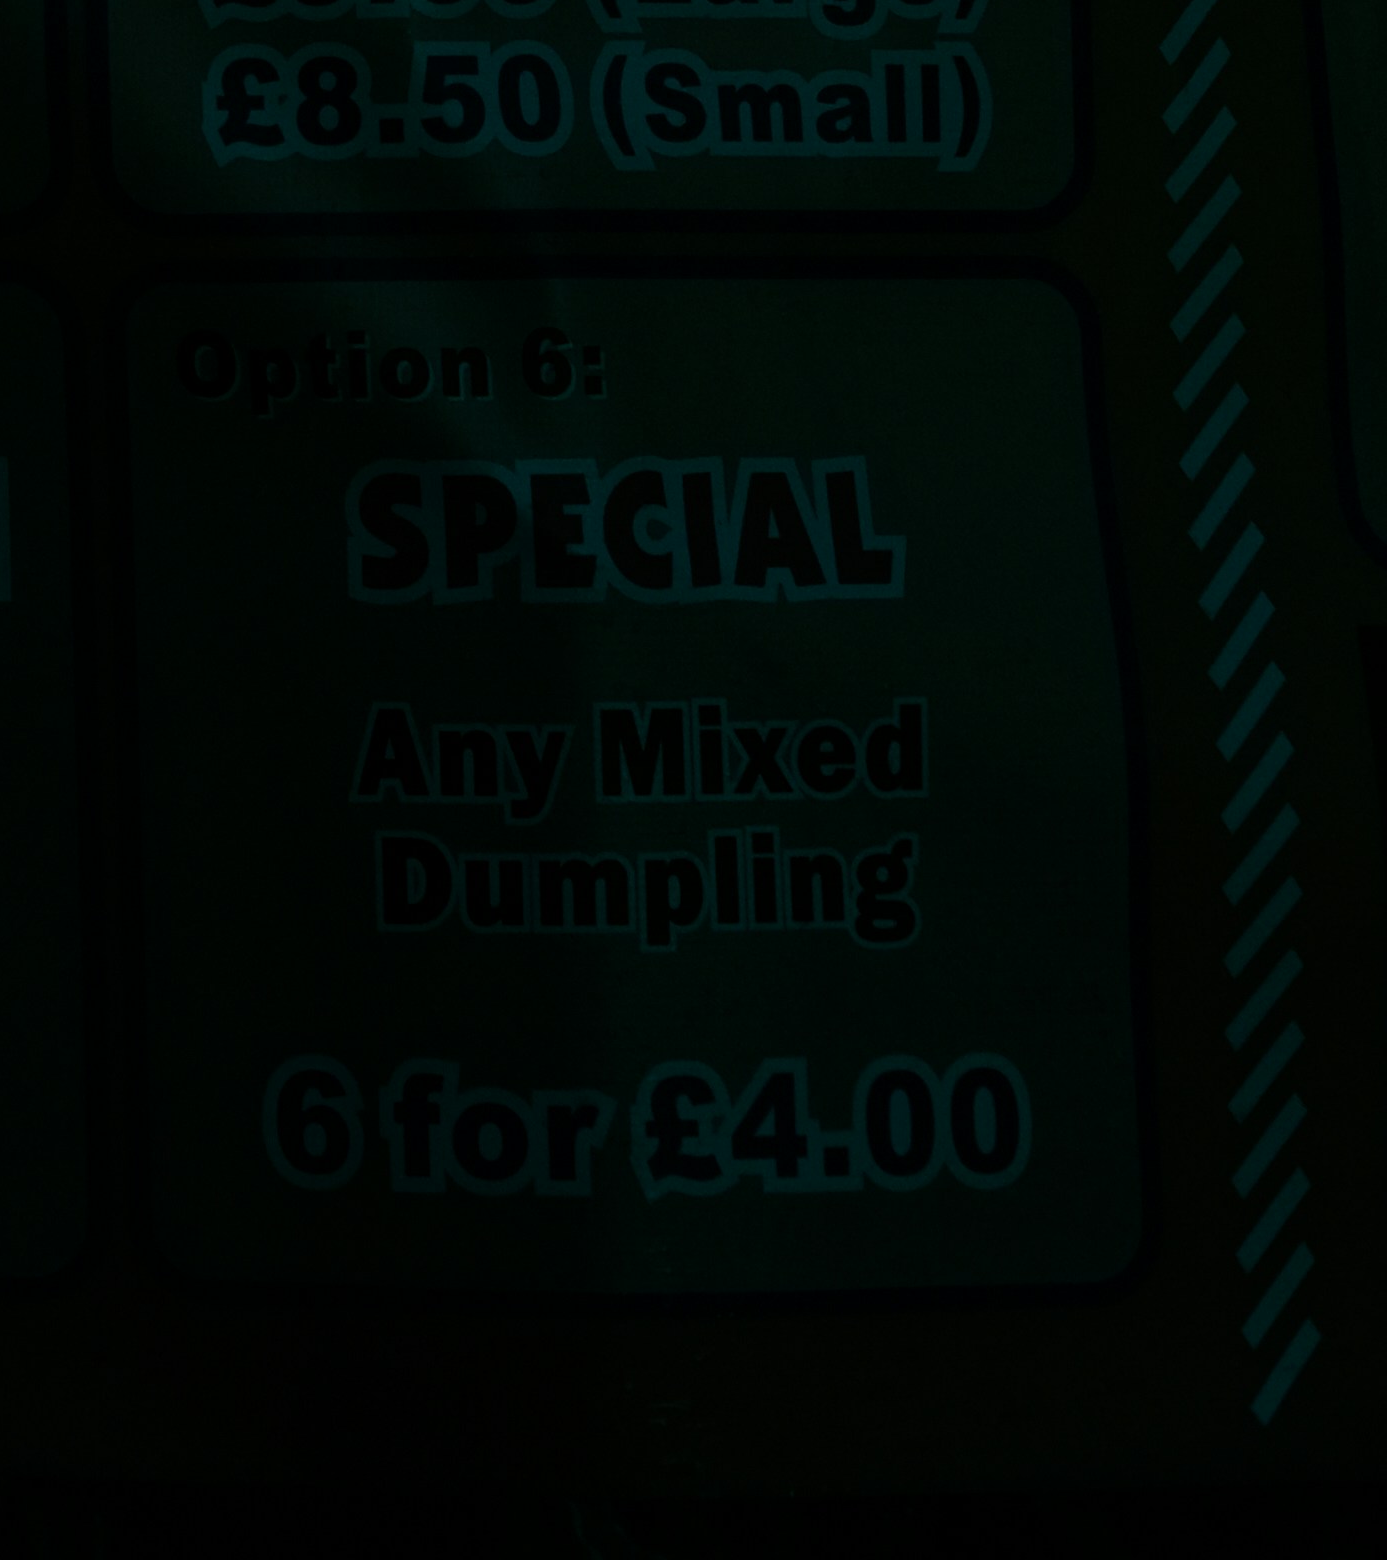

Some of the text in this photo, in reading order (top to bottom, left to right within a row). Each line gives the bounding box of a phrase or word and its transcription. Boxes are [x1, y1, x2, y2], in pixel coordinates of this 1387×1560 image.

[210, 47, 988, 164] £8.50 (Small)
[174, 325, 608, 418] Option 6:
[351, 463, 899, 597] SPECIAL
[354, 699, 926, 823] Any Mixed
[376, 829, 918, 949] Dumpling
[270, 1062, 1026, 1188] 6 for £4.00
